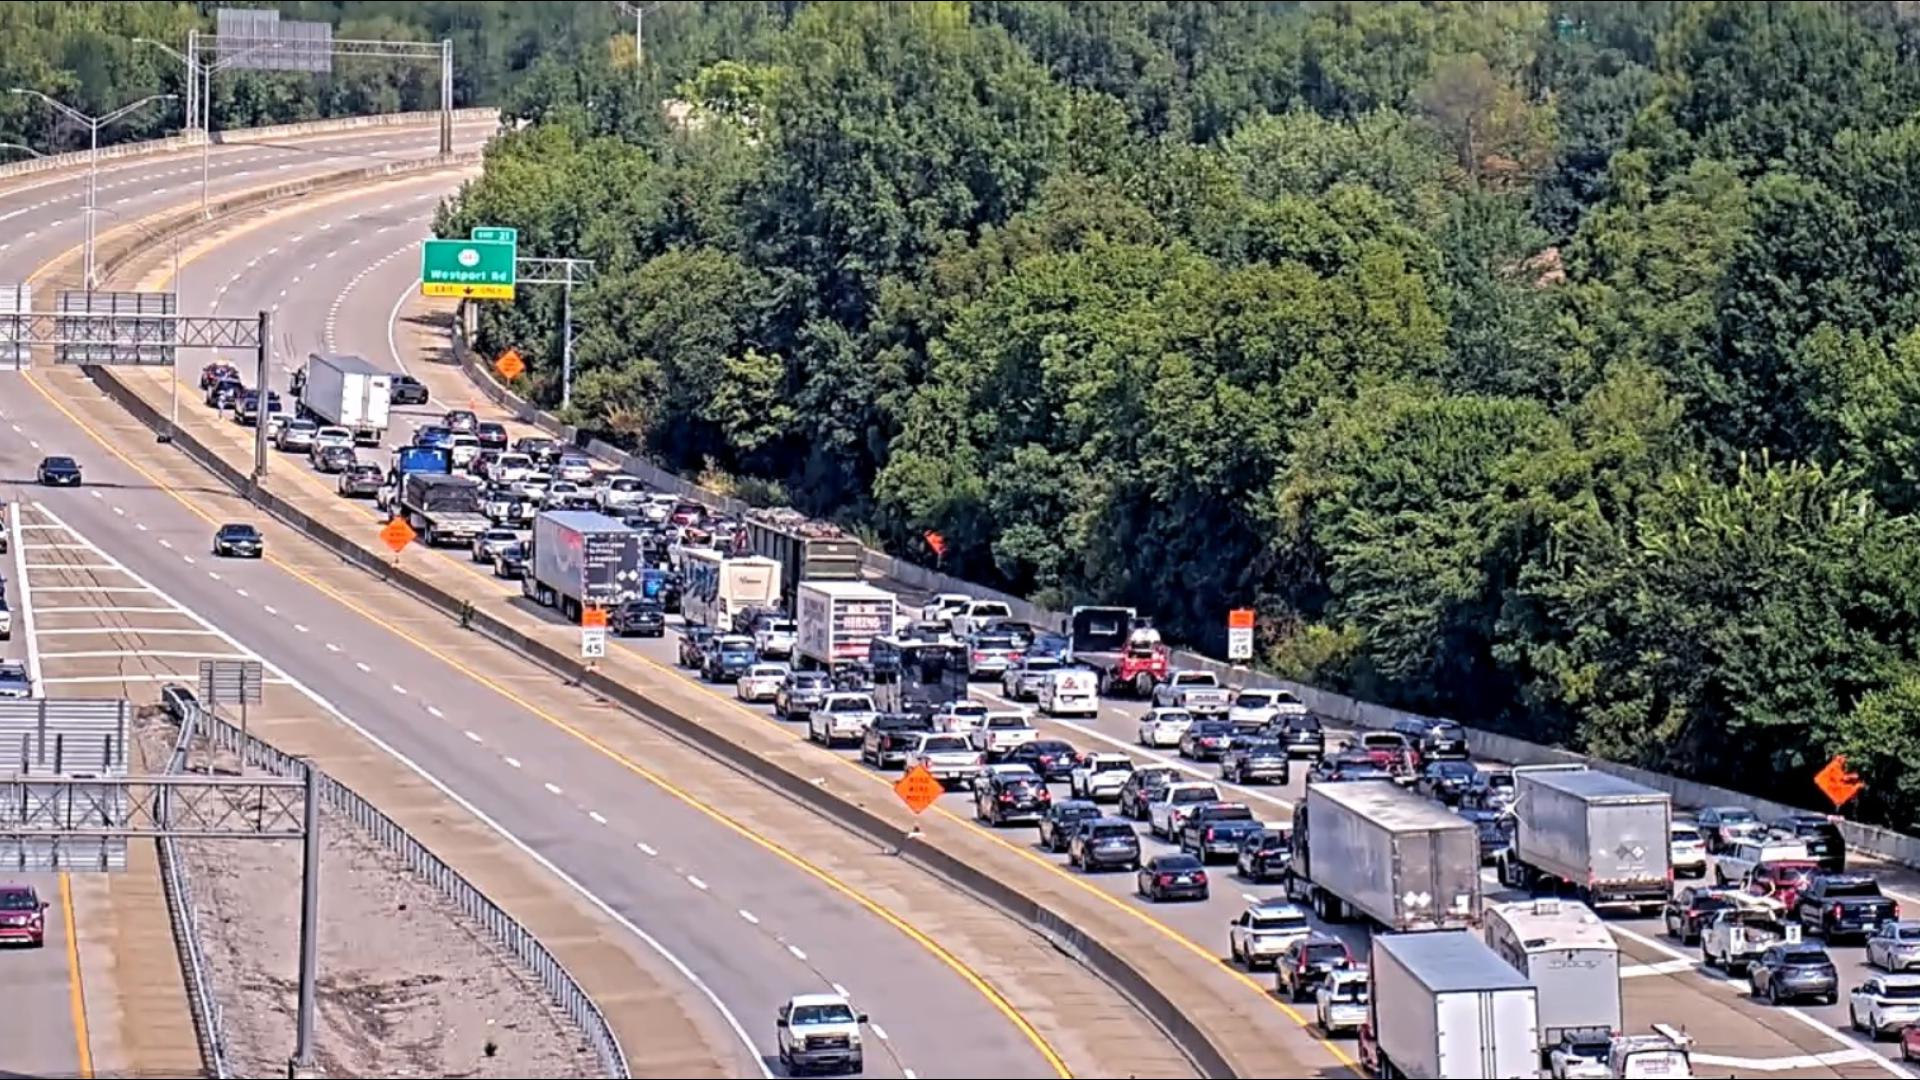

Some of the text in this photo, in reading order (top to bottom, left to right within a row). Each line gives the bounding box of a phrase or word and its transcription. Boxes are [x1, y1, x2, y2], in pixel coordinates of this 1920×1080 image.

[499, 232, 510, 240] 21
[431, 270, 507, 281] Westport Rd
[586, 643, 602, 655] 45
[1233, 644, 1249, 655] 45
